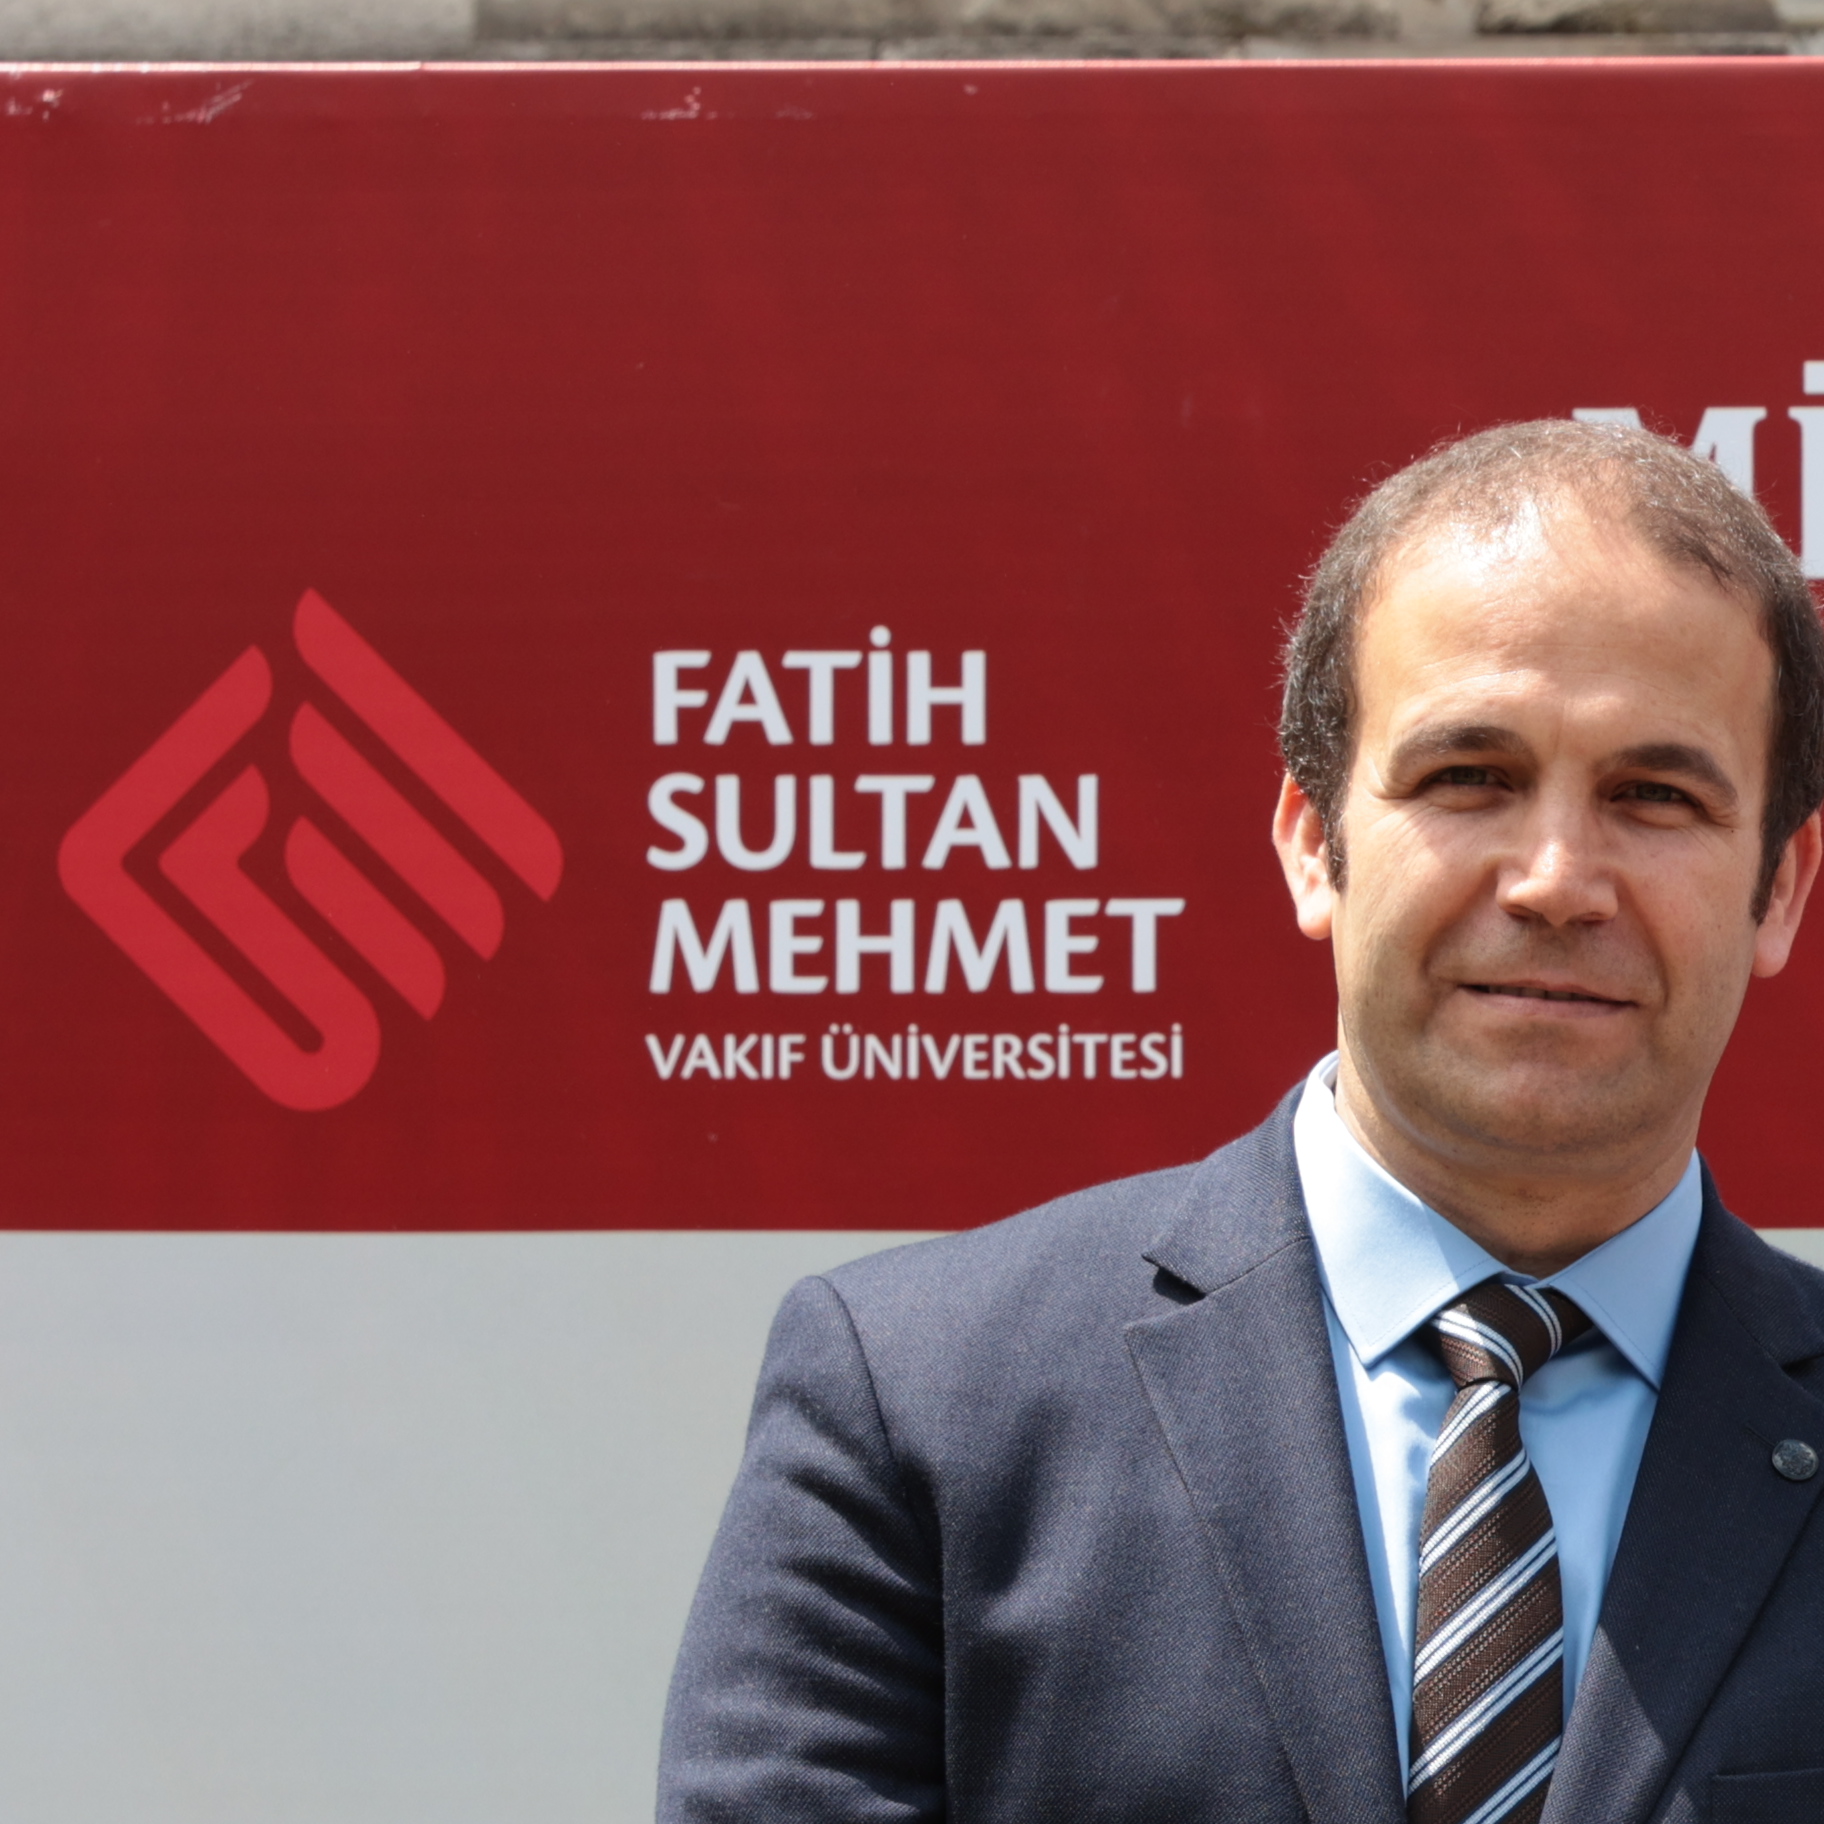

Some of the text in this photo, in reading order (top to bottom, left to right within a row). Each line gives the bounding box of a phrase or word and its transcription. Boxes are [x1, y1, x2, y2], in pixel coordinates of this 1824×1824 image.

[654, 626, 985, 744] FATİH
[647, 773, 1097, 870] SULTAN
[650, 899, 1184, 993] MEHMET
[646, 1024, 1182, 1079] VAKIF ÜNİVERSİTESİ
